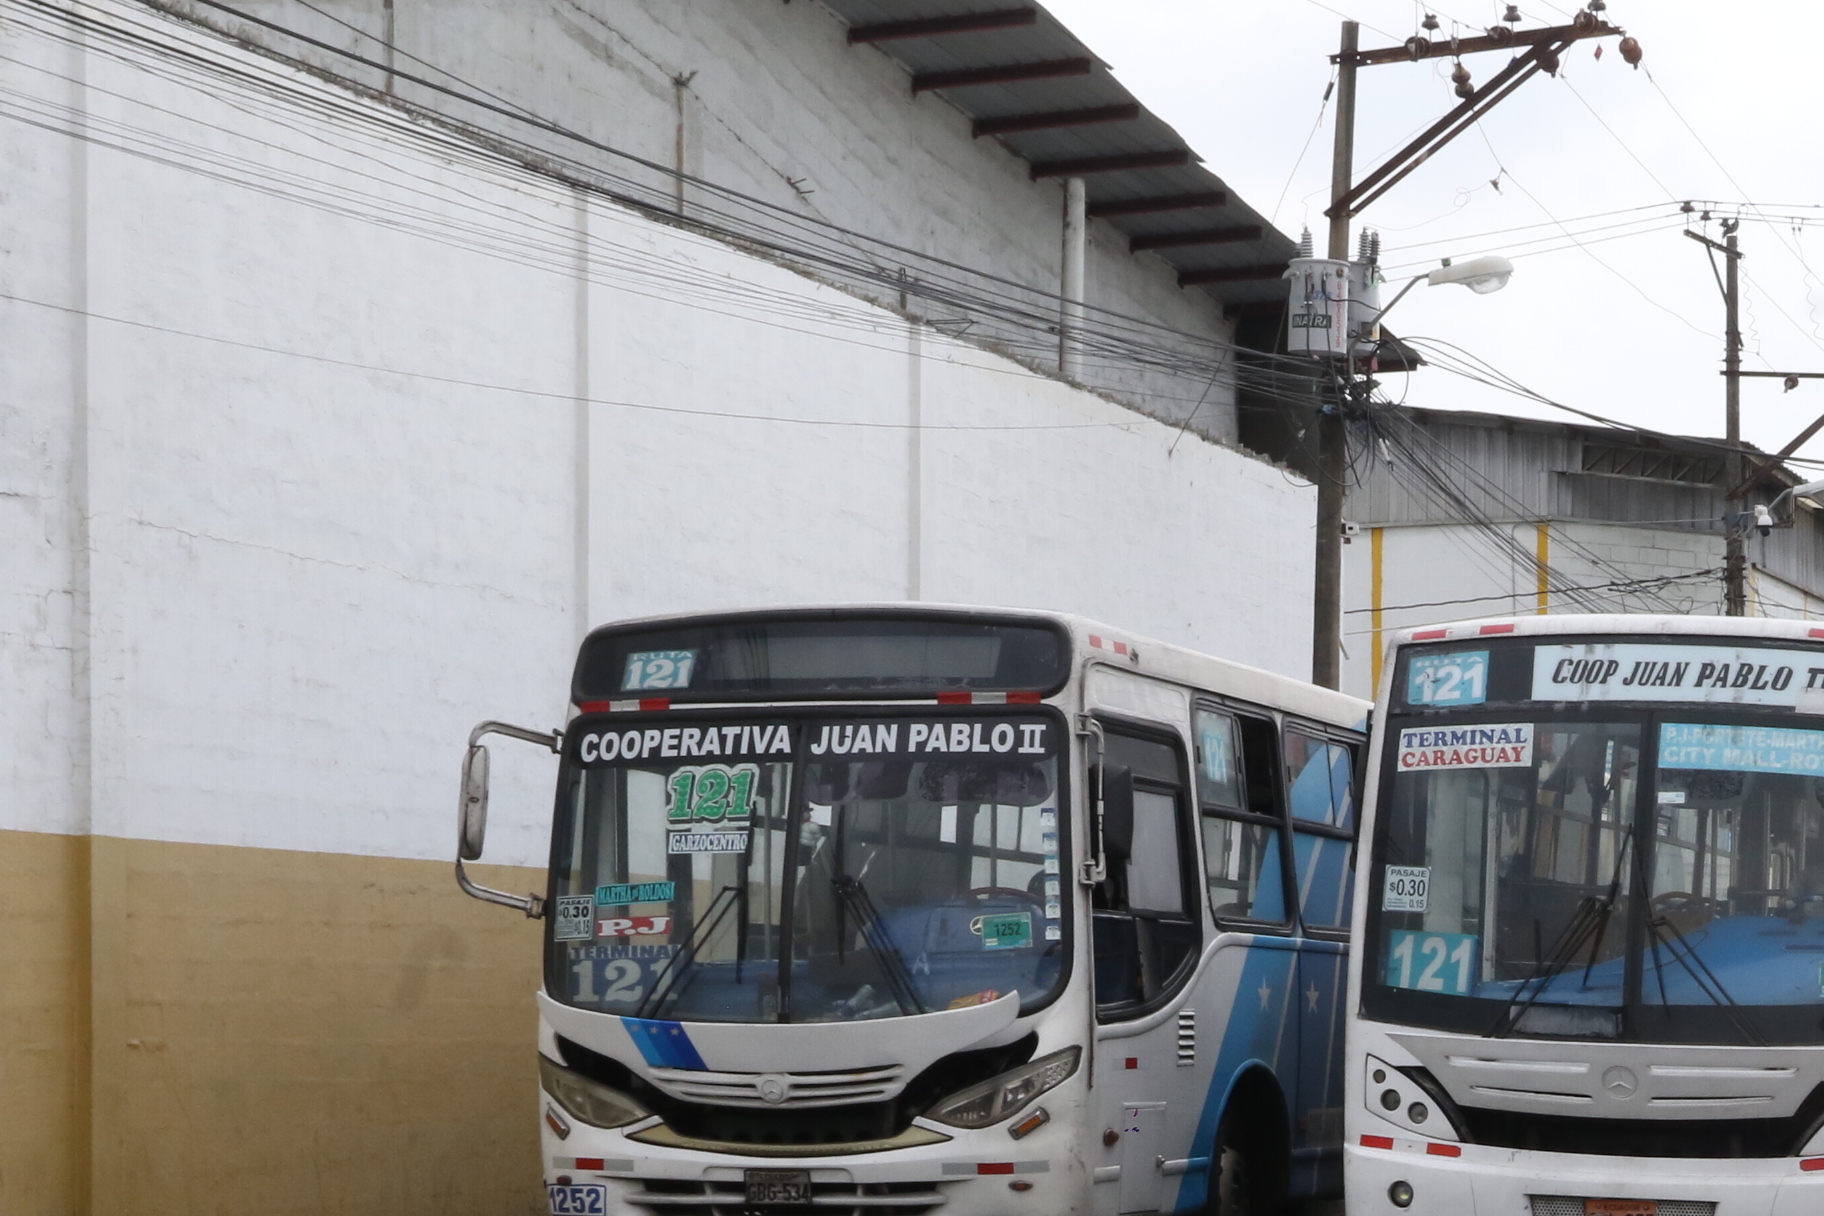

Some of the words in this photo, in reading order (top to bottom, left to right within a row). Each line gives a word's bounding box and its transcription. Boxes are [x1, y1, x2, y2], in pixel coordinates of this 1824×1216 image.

[632, 650, 693, 660] RUTA
[1416, 656, 1483, 668] RUTA
[626, 658, 693, 690] 121
[1414, 662, 1484, 702] 121
[1552, 658, 1619, 685] COOP
[1622, 661, 1690, 688] JUAN
[1693, 662, 1794, 691] PABLO
[580, 725, 792, 763] COOPERATIVA
[810, 723, 899, 755] JUAN
[907, 723, 1015, 753] PABLO
[1017, 724, 1047, 754] II
[1402, 727, 1528, 749] TERMINAL
[1401, 746, 1526, 768] CARAGUAY
[1664, 746, 1717, 763] CITY
[667, 768, 753, 821] 121
[672, 833, 749, 851] GARZOCENTRO
[1390, 868, 1427, 878] PASAJE
[1389, 879, 1426, 897] $0.30
[597, 916, 671, 936] P.J
[995, 922, 1021, 937] 1252
[1393, 934, 1473, 993] 121
[572, 958, 679, 1002] 121
[549, 1187, 603, 1213] 1252
[1603, 1203, 1640, 1211] ECUADOR
